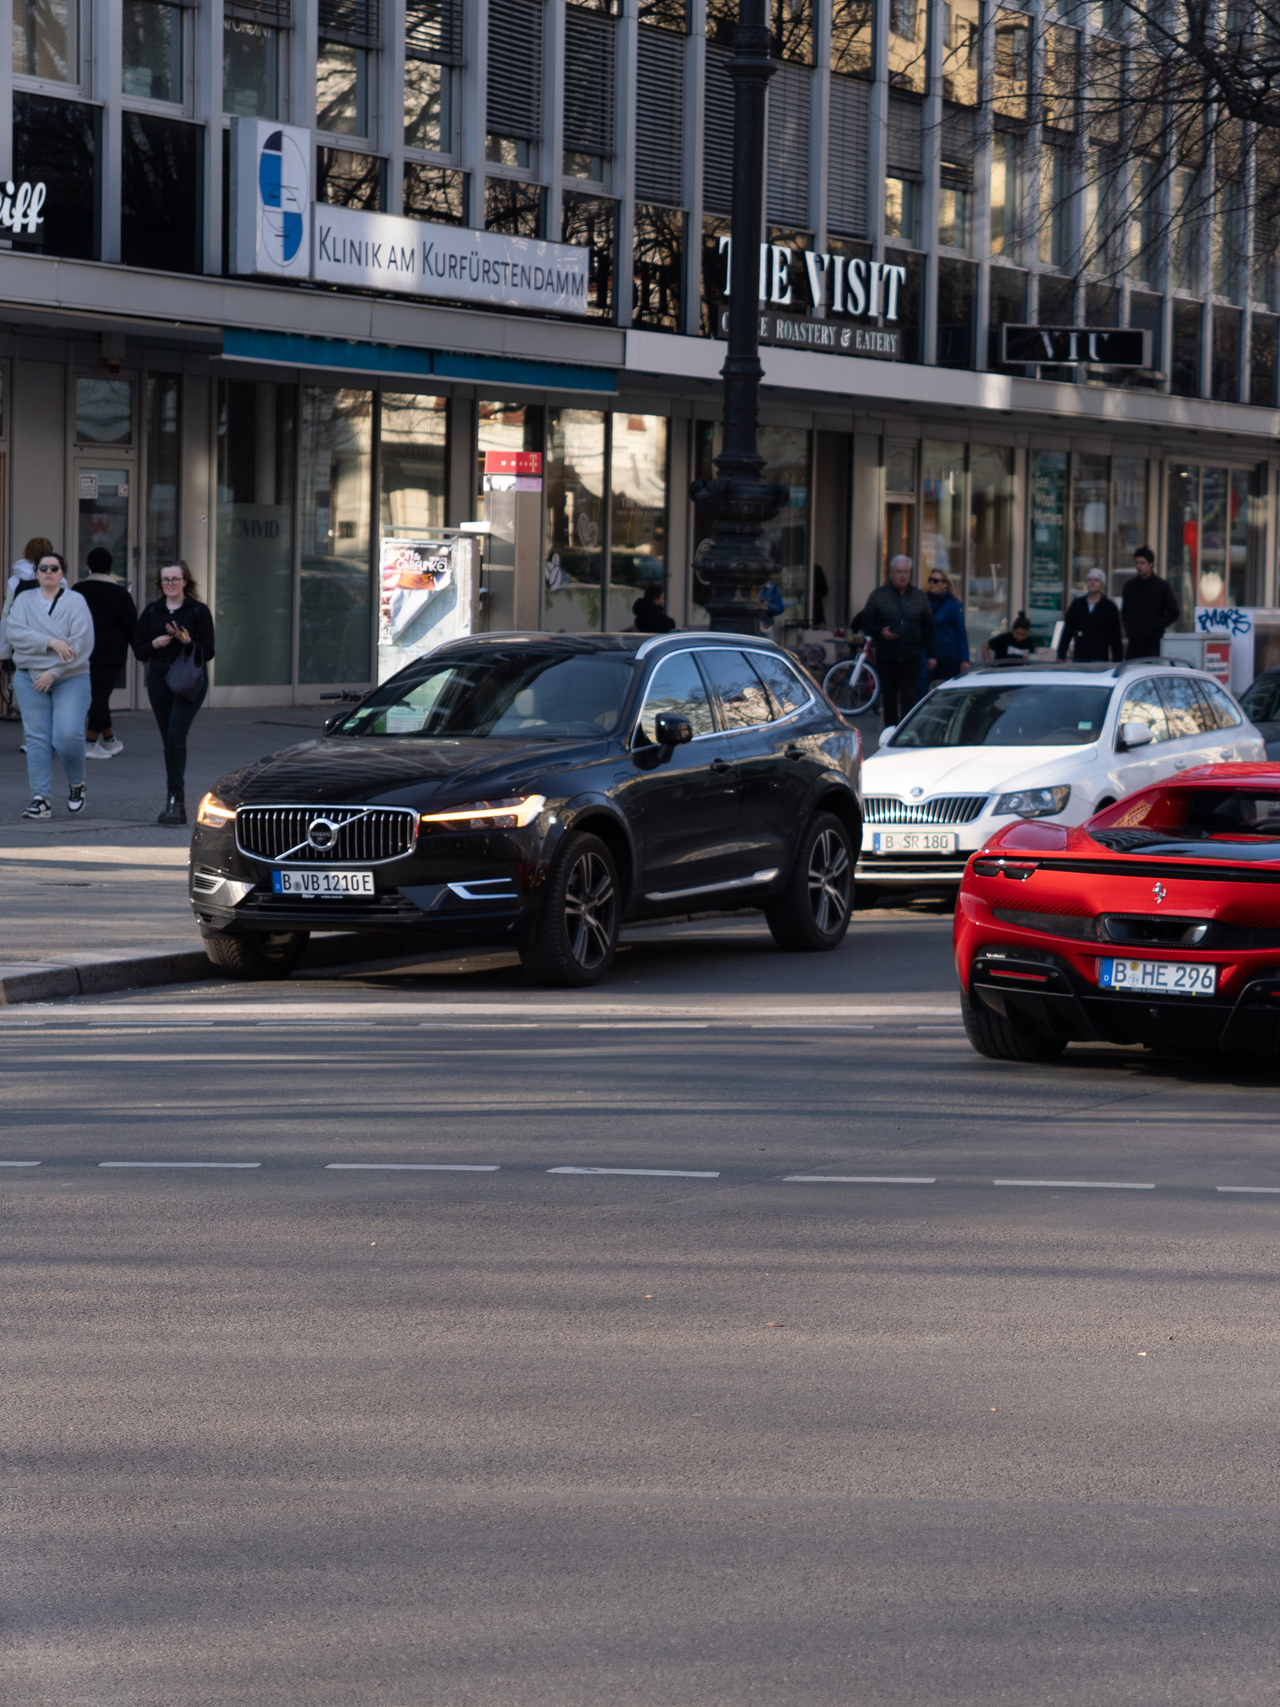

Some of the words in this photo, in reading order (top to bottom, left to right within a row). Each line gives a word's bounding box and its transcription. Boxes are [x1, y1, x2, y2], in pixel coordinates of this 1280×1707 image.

[0, 181, 47, 233] iff
[319, 225, 382, 269] KLINIK
[387, 245, 415, 273] AM
[422, 241, 585, 297] KURFÜRSTENDAMM
[804, 250, 907, 320] VISIT
[776, 318, 837, 345] ROASTERY
[840, 328, 852, 348] &
[855, 329, 898, 353] EATERY
[886, 835, 894, 849] B
[903, 835, 919, 849] SR
[923, 835, 948, 849] 180
[283, 873, 292, 890] B
[301, 874, 320, 891] VB
[1113, 962, 1127, 983] B
[1141, 963, 1168, 986] HE
[1174, 966, 1213, 989] 296
